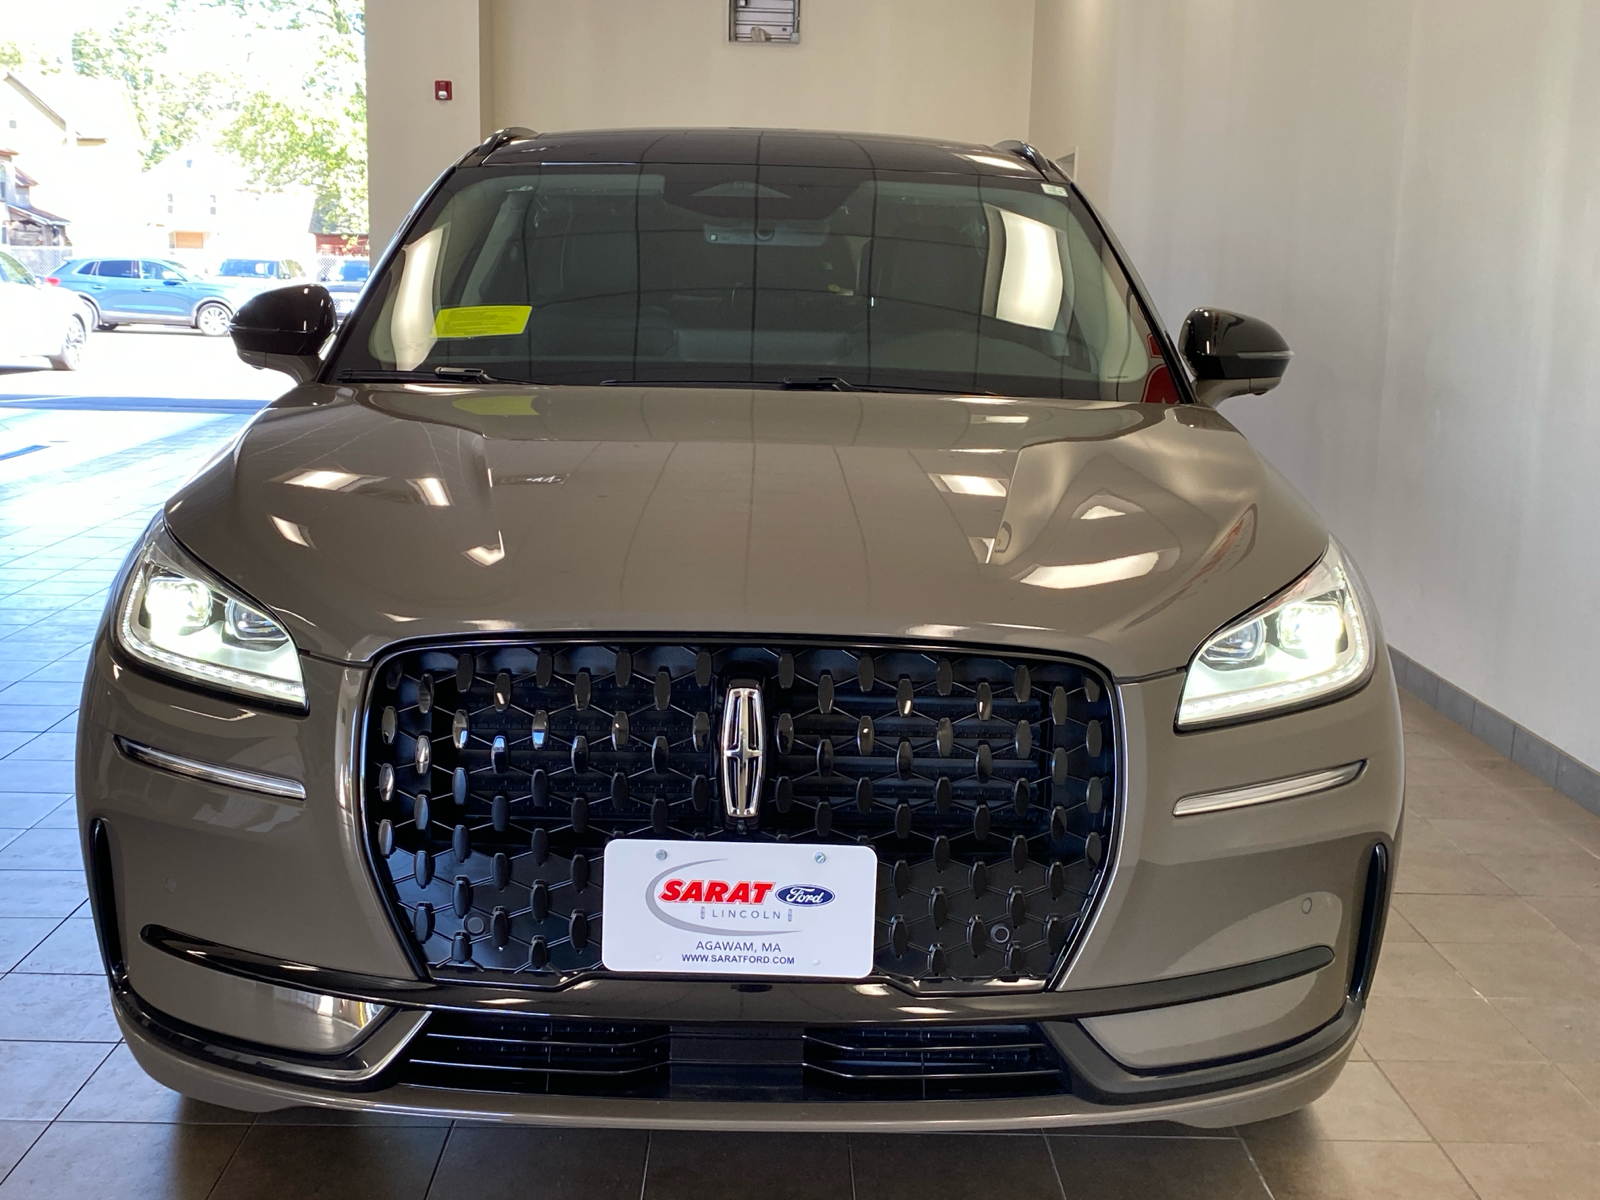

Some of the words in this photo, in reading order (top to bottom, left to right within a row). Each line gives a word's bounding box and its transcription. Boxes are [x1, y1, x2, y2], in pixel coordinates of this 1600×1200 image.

[658, 879, 776, 905] SARAT
[785, 886, 825, 904] Ford
[712, 909, 781, 919] LINCOLN
[696, 941, 758, 953] AGAWAM,
[761, 942, 782, 953] MA
[681, 954, 795, 965] WWW.SARATFORD.COM
